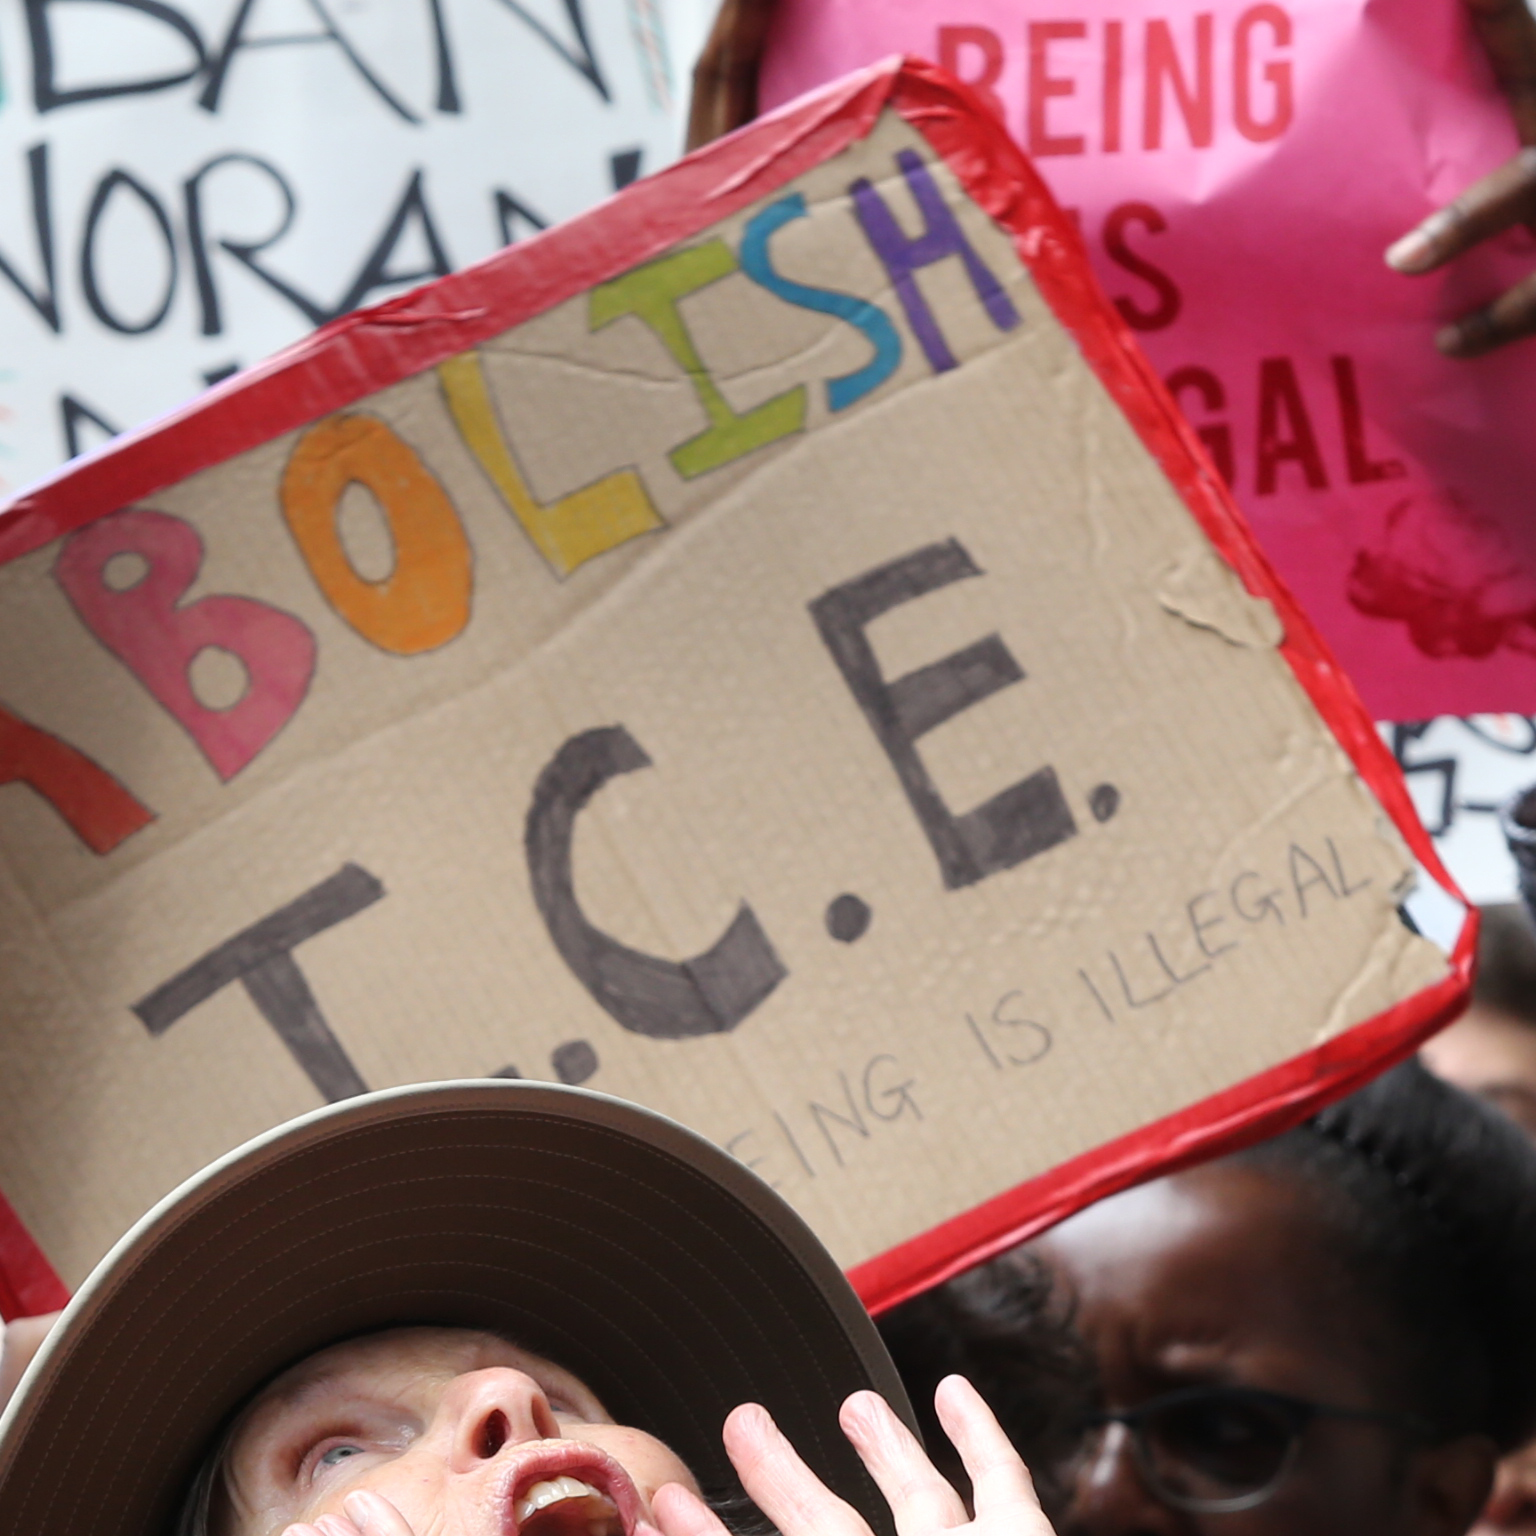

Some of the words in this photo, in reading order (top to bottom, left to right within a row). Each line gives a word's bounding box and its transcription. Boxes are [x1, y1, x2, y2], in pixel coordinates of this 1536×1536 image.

[936, 4, 1296, 159] BEING
[964, 988, 1054, 1072] IS
[1076, 837, 1373, 1024] ILLEGAL
